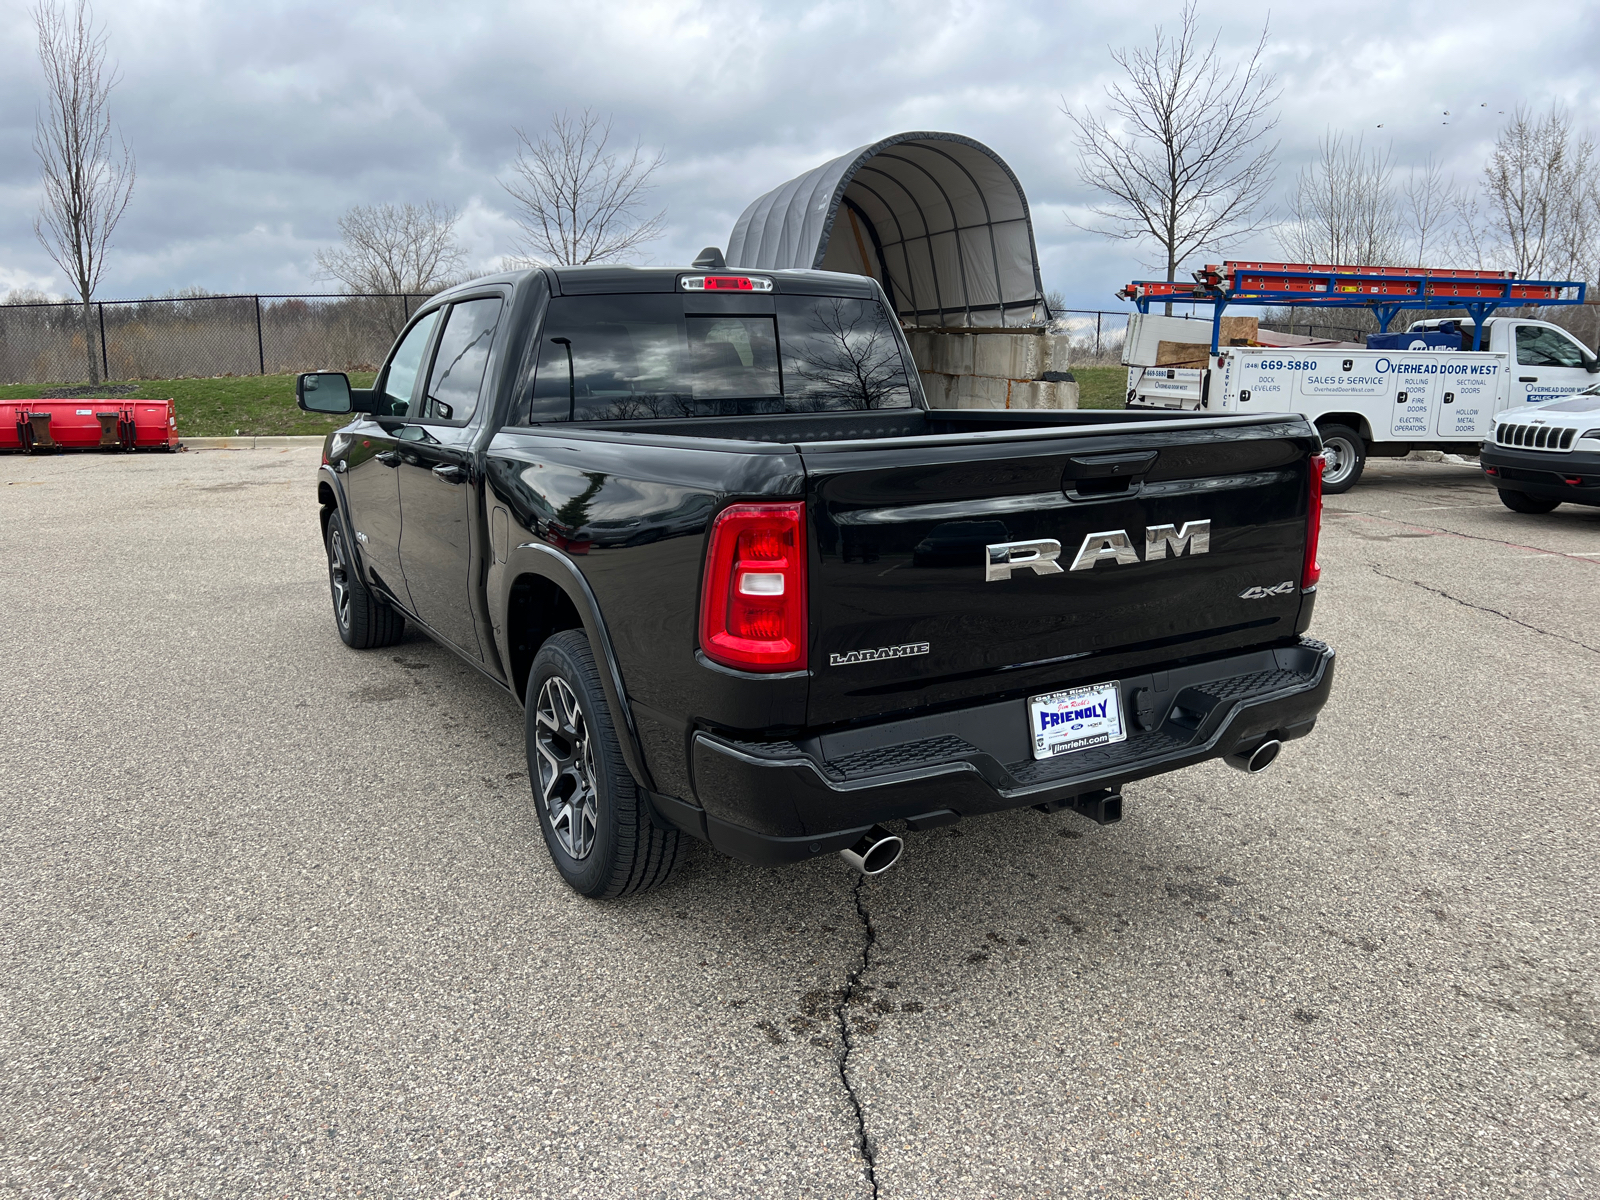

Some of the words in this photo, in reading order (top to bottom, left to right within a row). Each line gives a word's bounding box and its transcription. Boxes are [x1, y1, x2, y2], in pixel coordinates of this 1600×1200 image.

[1261, 360, 1317, 370] 669-5880
[1440, 365, 1468, 374] DOOR
[1470, 365, 1498, 375] WEST
[1307, 376, 1336, 384] SALES
[1346, 377, 1384, 385] SERVICE
[986, 519, 1211, 582] RAM
[830, 642, 930, 666] LARAMIE
[1069, 687, 1091, 695] Riehl
[1057, 703, 1069, 712] Jim
[1070, 699, 1090, 708] Riehl's
[1040, 698, 1107, 731] FRIENDLY
[1054, 734, 1108, 753] jimriehl.com
